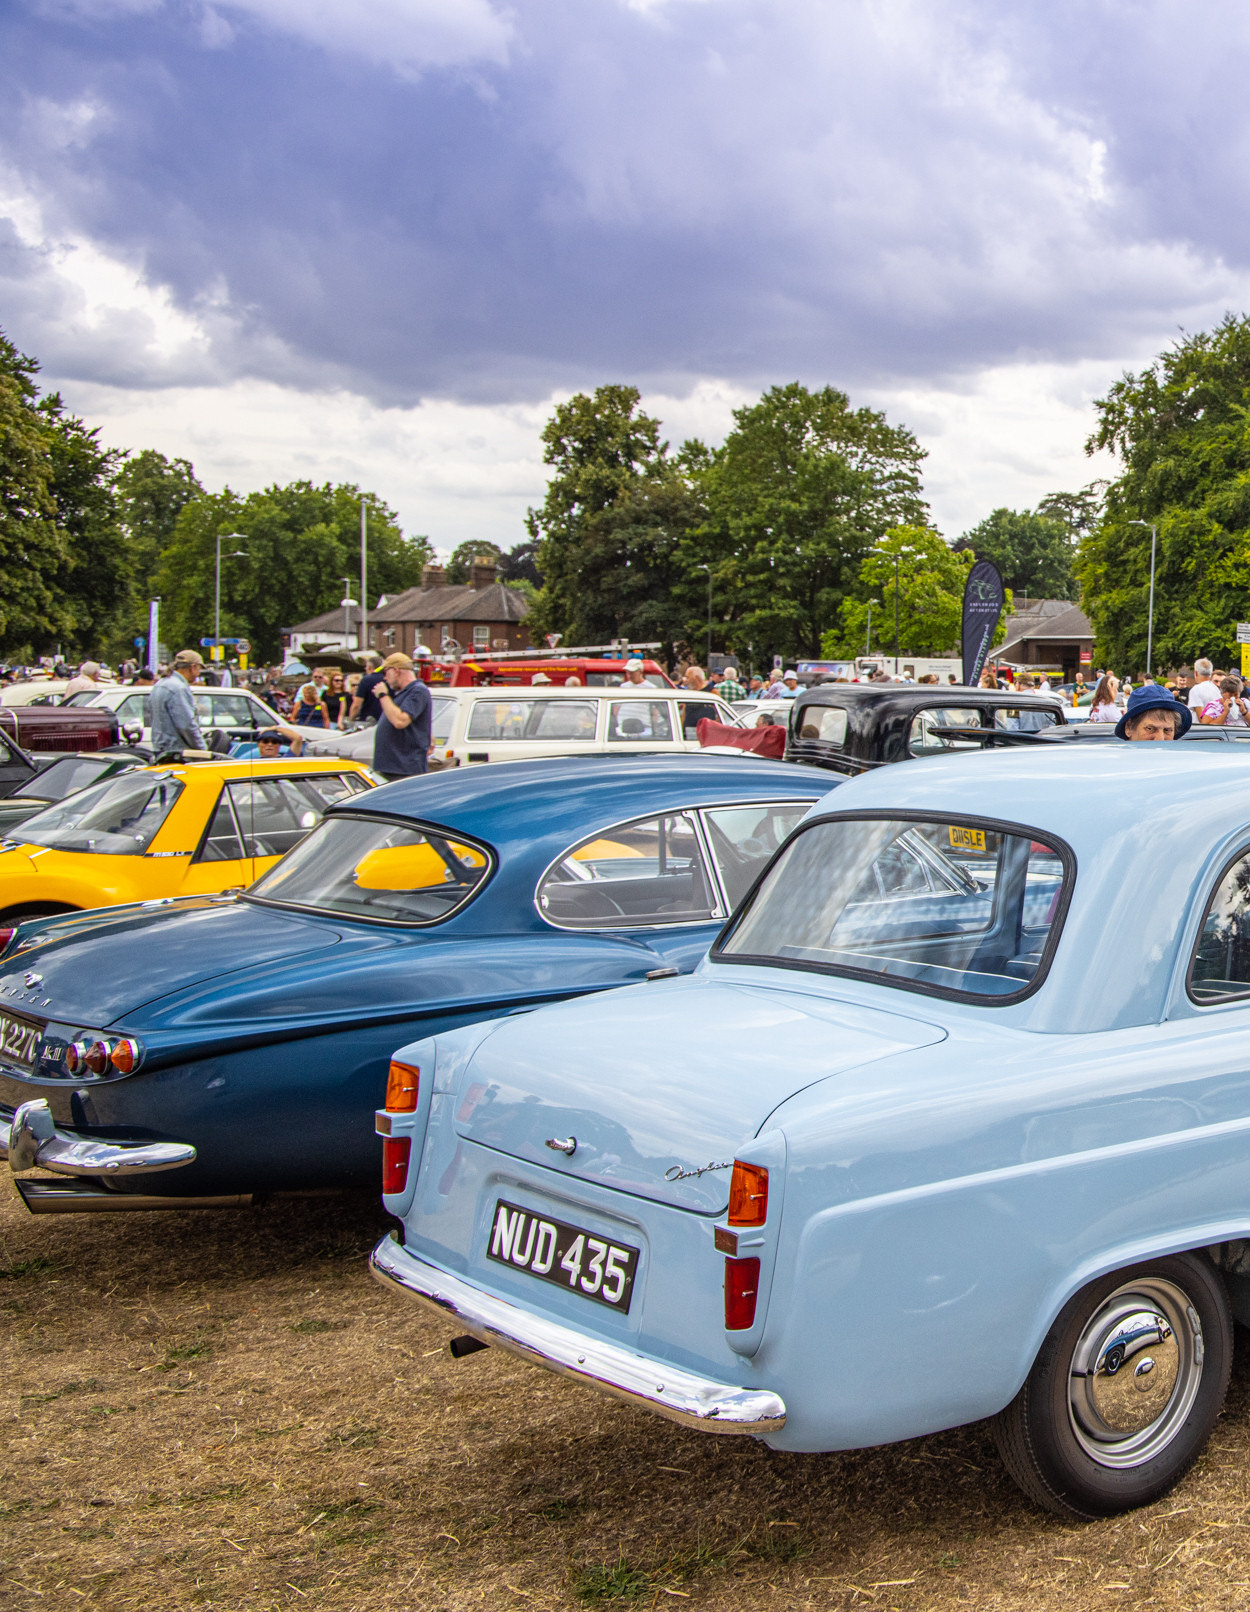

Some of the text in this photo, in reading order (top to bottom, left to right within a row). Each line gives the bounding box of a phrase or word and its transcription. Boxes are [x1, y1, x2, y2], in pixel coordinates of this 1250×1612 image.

[0, 986, 53, 1007] ENSEN
[491, 1206, 630, 1303] NUD 435
